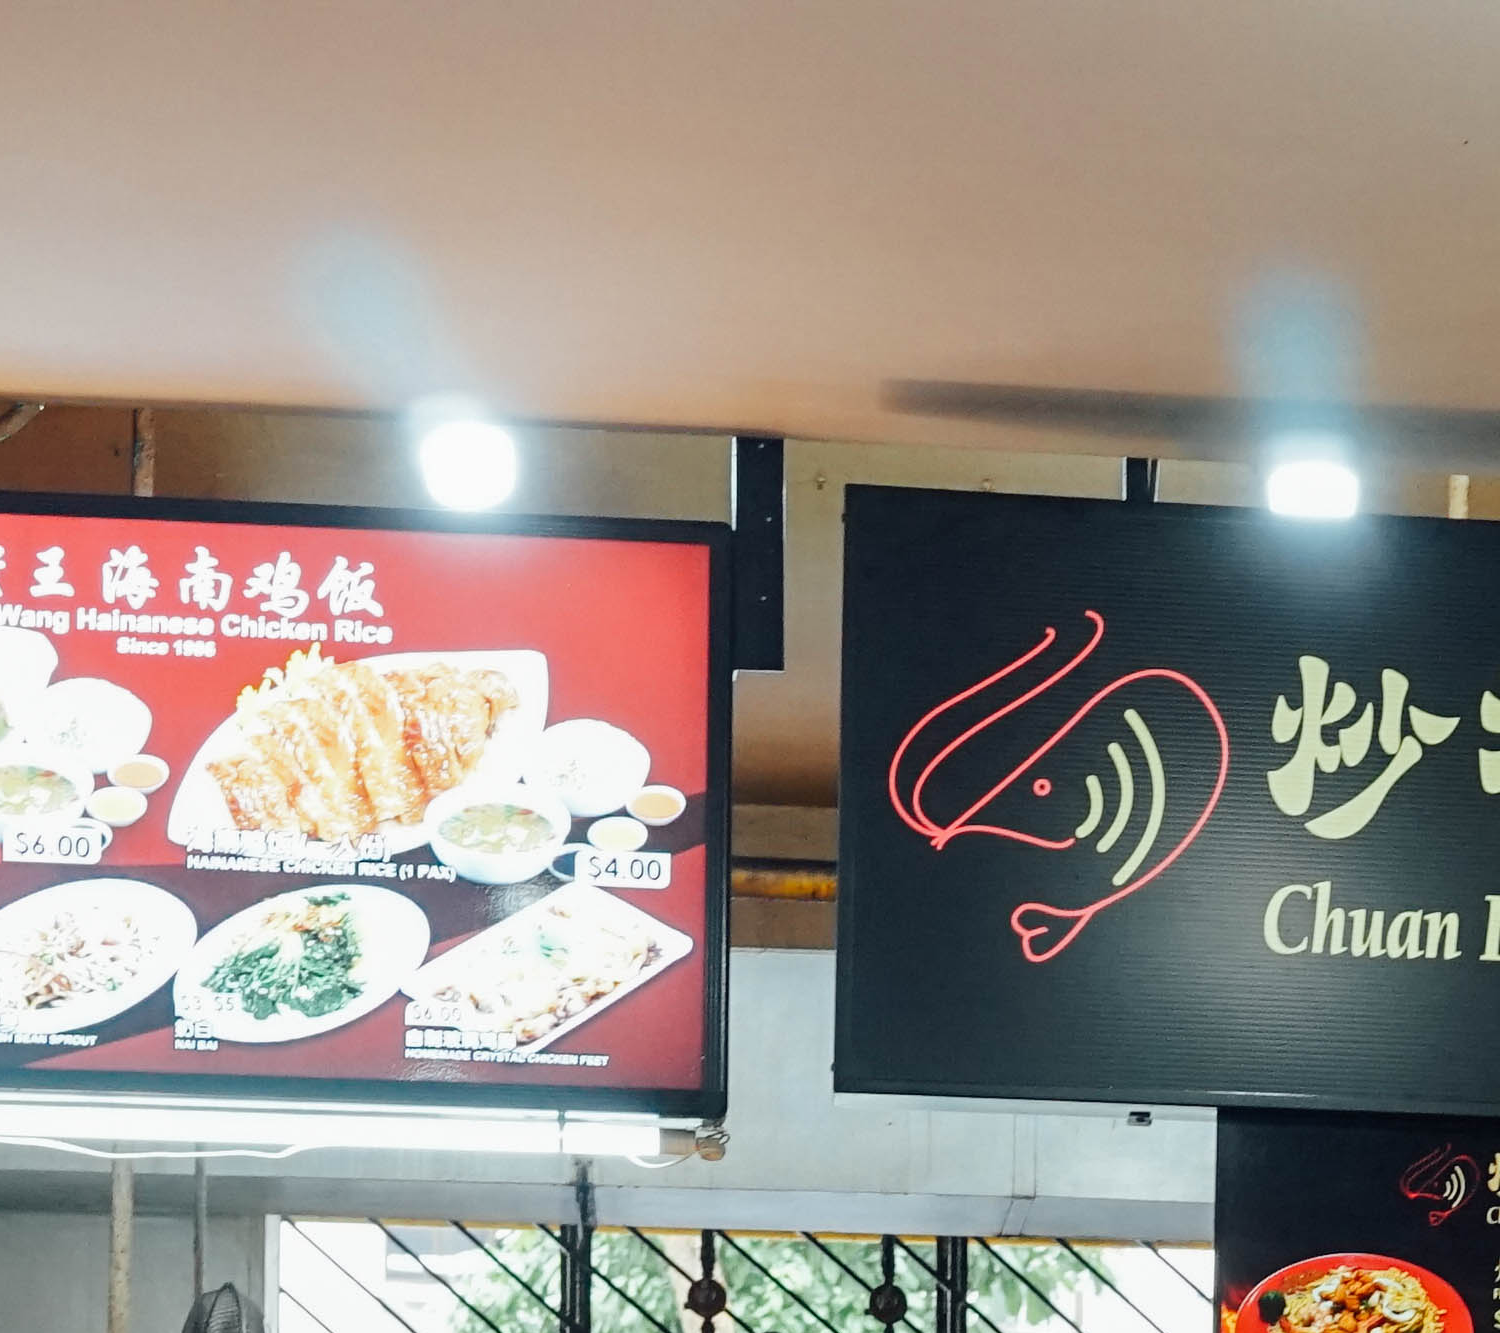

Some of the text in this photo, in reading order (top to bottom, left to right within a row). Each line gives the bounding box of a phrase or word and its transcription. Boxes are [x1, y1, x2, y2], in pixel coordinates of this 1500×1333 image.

[76, 606, 215, 638] Hainanese
[221, 612, 327, 643] Chicken
[334, 618, 393, 645] Rice
[14, 832, 92, 858] $6.00
[187, 855, 280, 872] HAINANESE
[283, 859, 355, 875] CHICKEN
[358, 863, 397, 877] RICE
[417, 866, 456, 882] PAX)
[589, 857, 662, 881] $4.00
[1263, 882, 1459, 963] Chuan
